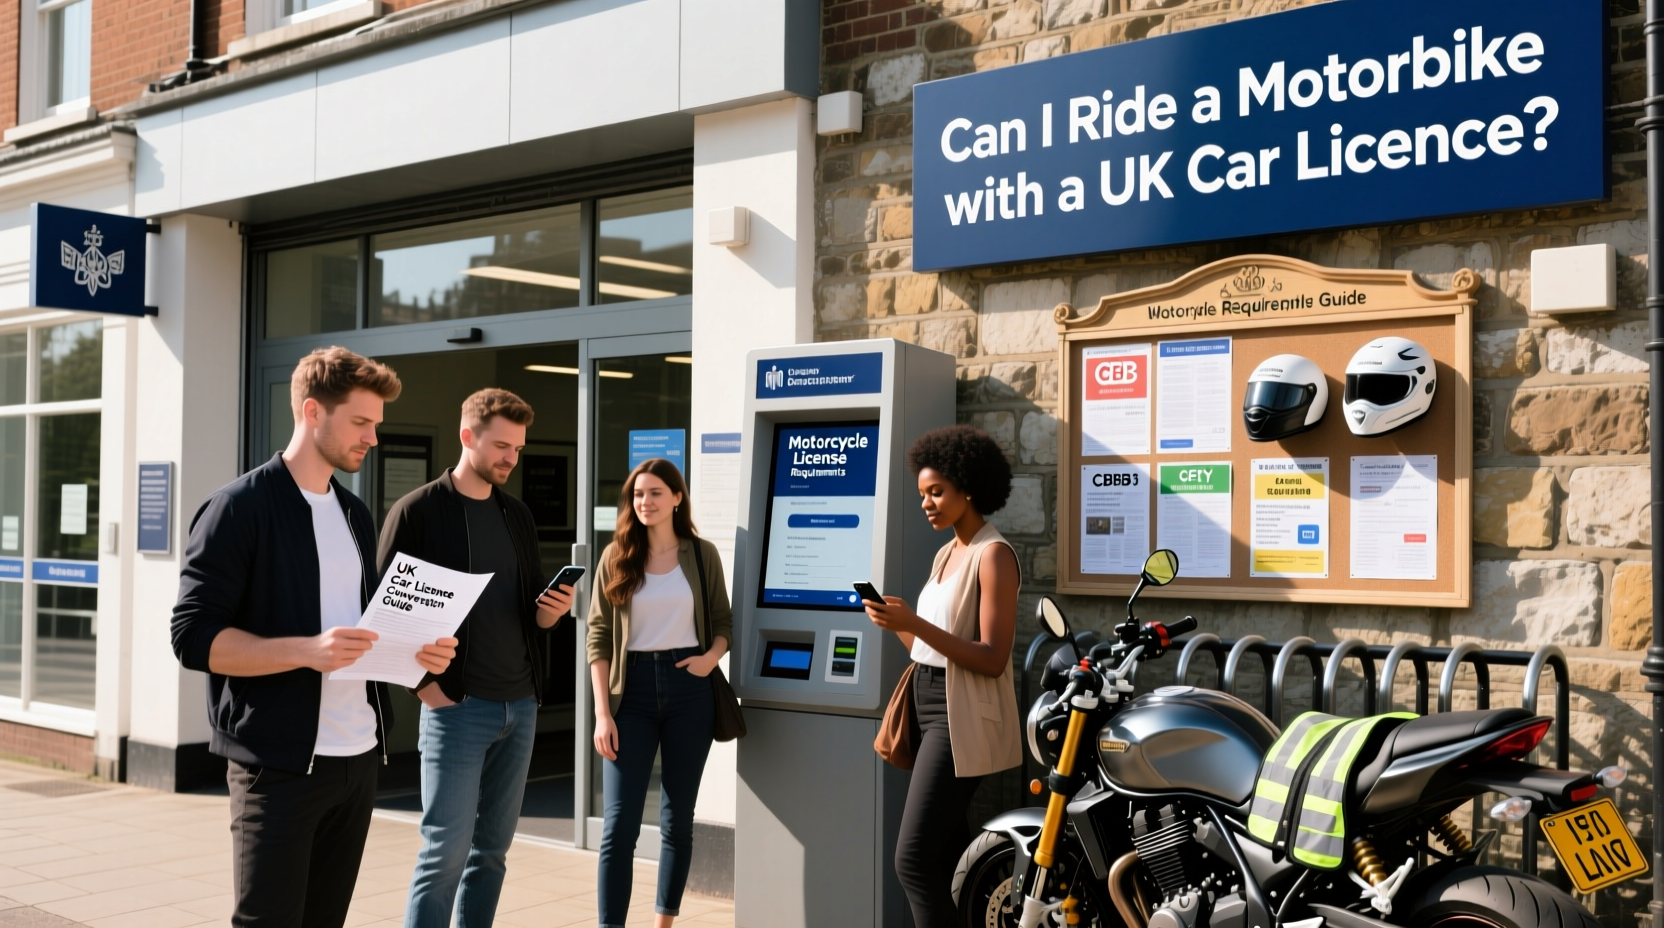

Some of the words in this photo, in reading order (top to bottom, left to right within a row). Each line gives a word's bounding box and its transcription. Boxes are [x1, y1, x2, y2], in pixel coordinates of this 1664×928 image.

[941, 117, 1026, 163] Can
[1042, 103, 1053, 147] I
[1069, 84, 1176, 143] Ride
[1191, 85, 1221, 124] a
[1238, 25, 1544, 117] Motorbike
[944, 171, 1044, 226] with
[1057, 176, 1085, 212] a
[1101, 152, 1174, 206] UK
[1188, 144, 1280, 193] Car
[1297, 96, 1559, 181] Licence?
[1319, 290, 1367, 307] Guide
[788, 432, 869, 453] Motorcycle
[793, 451, 847, 465] License
[397, 562, 418, 577] UK
[391, 575, 412, 588] Car
